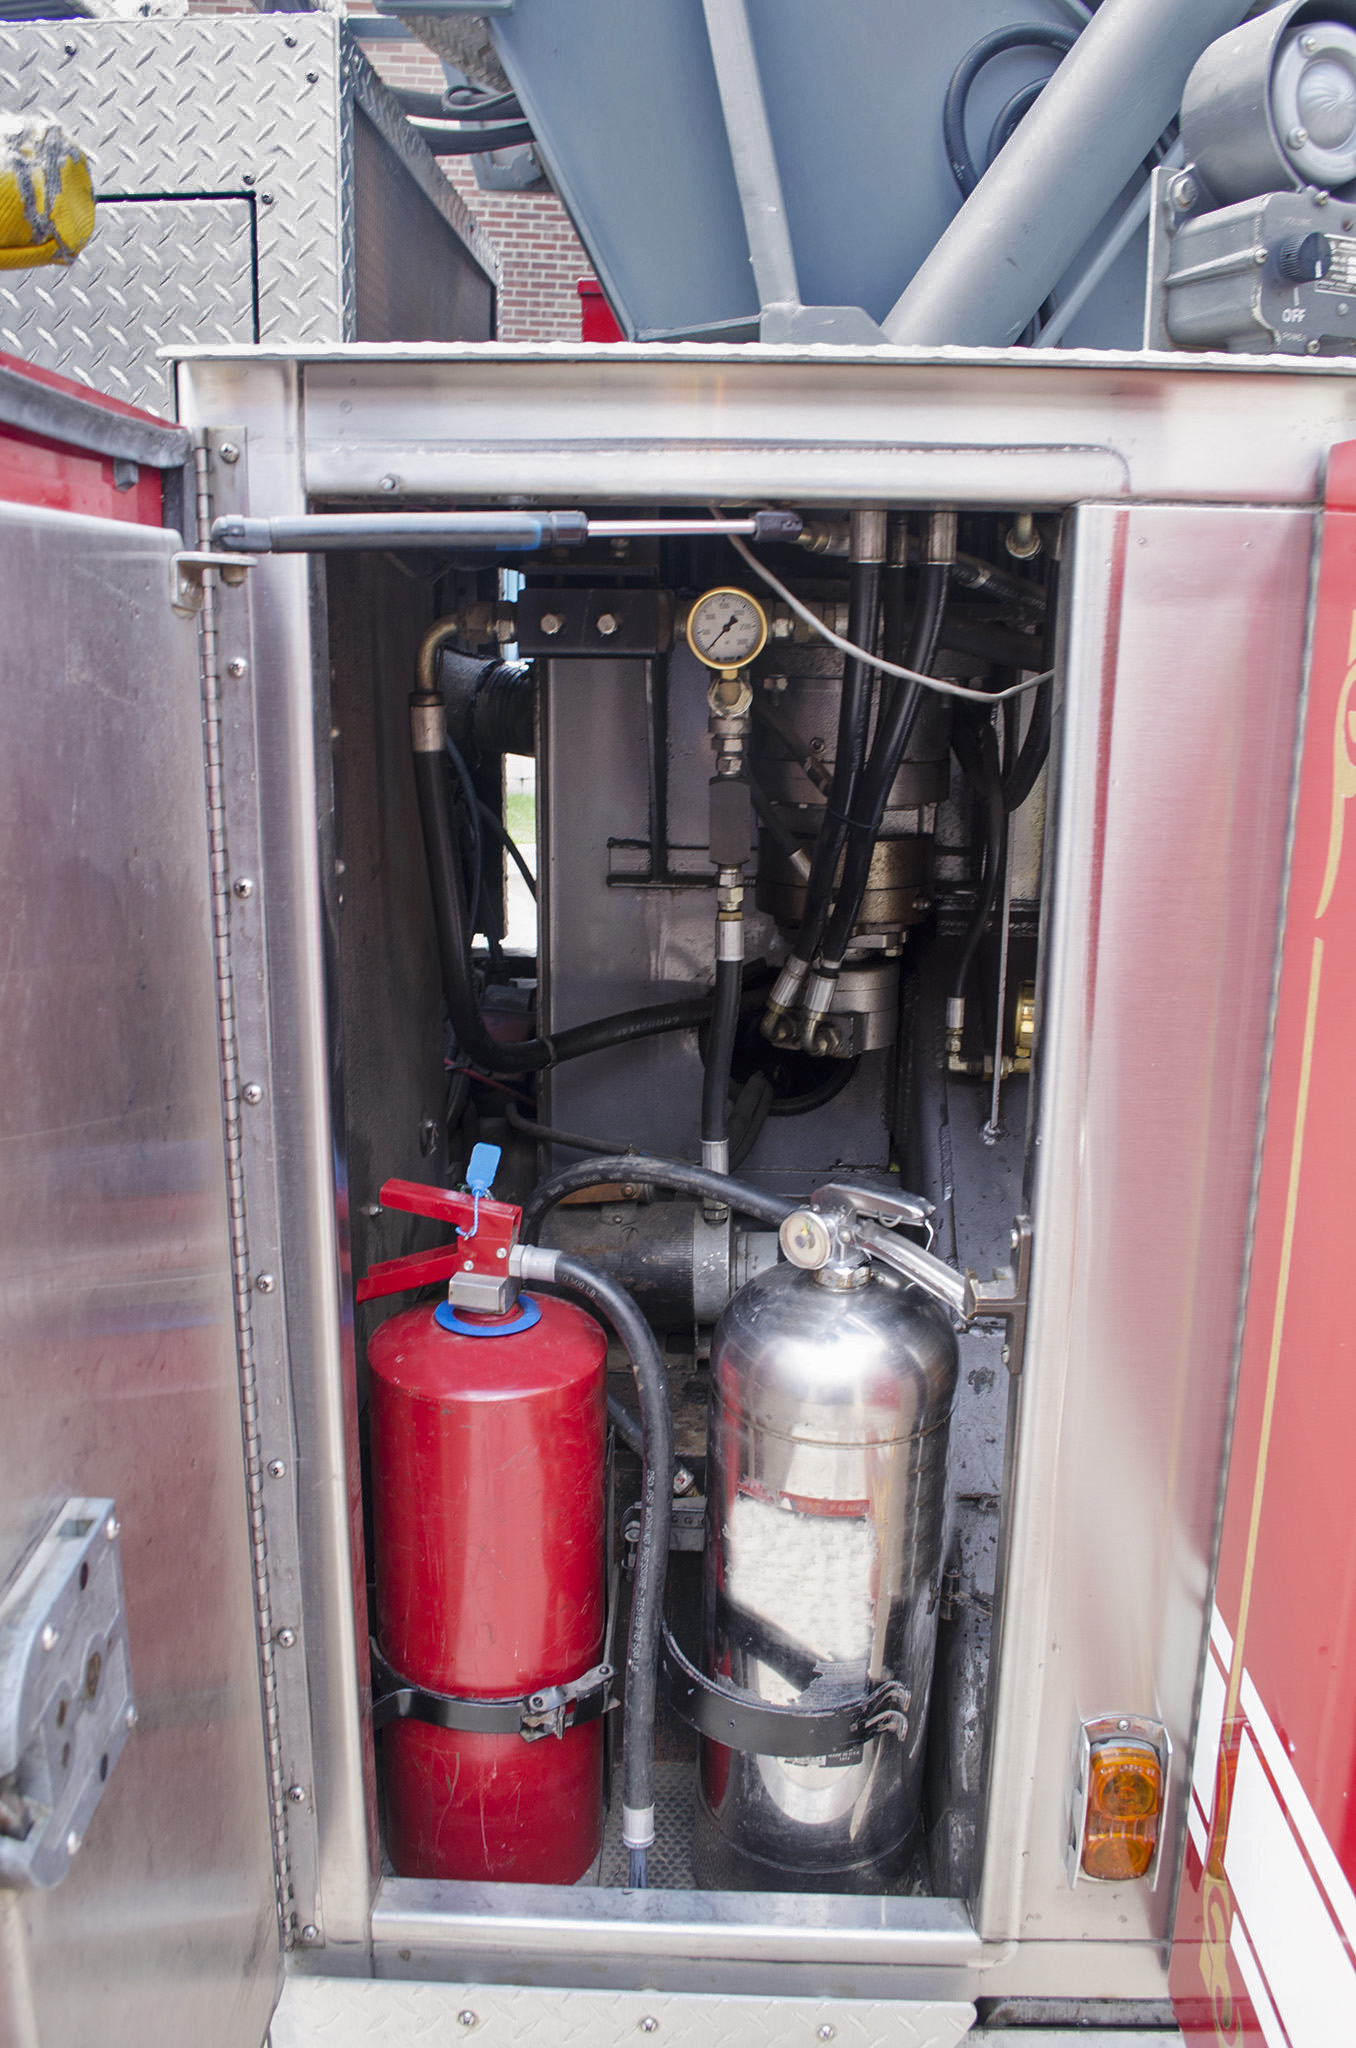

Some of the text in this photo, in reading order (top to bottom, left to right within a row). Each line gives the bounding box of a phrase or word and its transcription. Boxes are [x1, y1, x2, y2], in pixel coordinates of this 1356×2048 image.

[1281, 307, 1307, 323] OFF
[646, 1469, 655, 1487] 250
[645, 1489, 655, 1504] PSI
[643, 1506, 654, 1545] WORKING
[634, 1597, 646, 1629] TESTED
[633, 1629, 643, 1642] TO
[631, 1643, 641, 1659] 500
